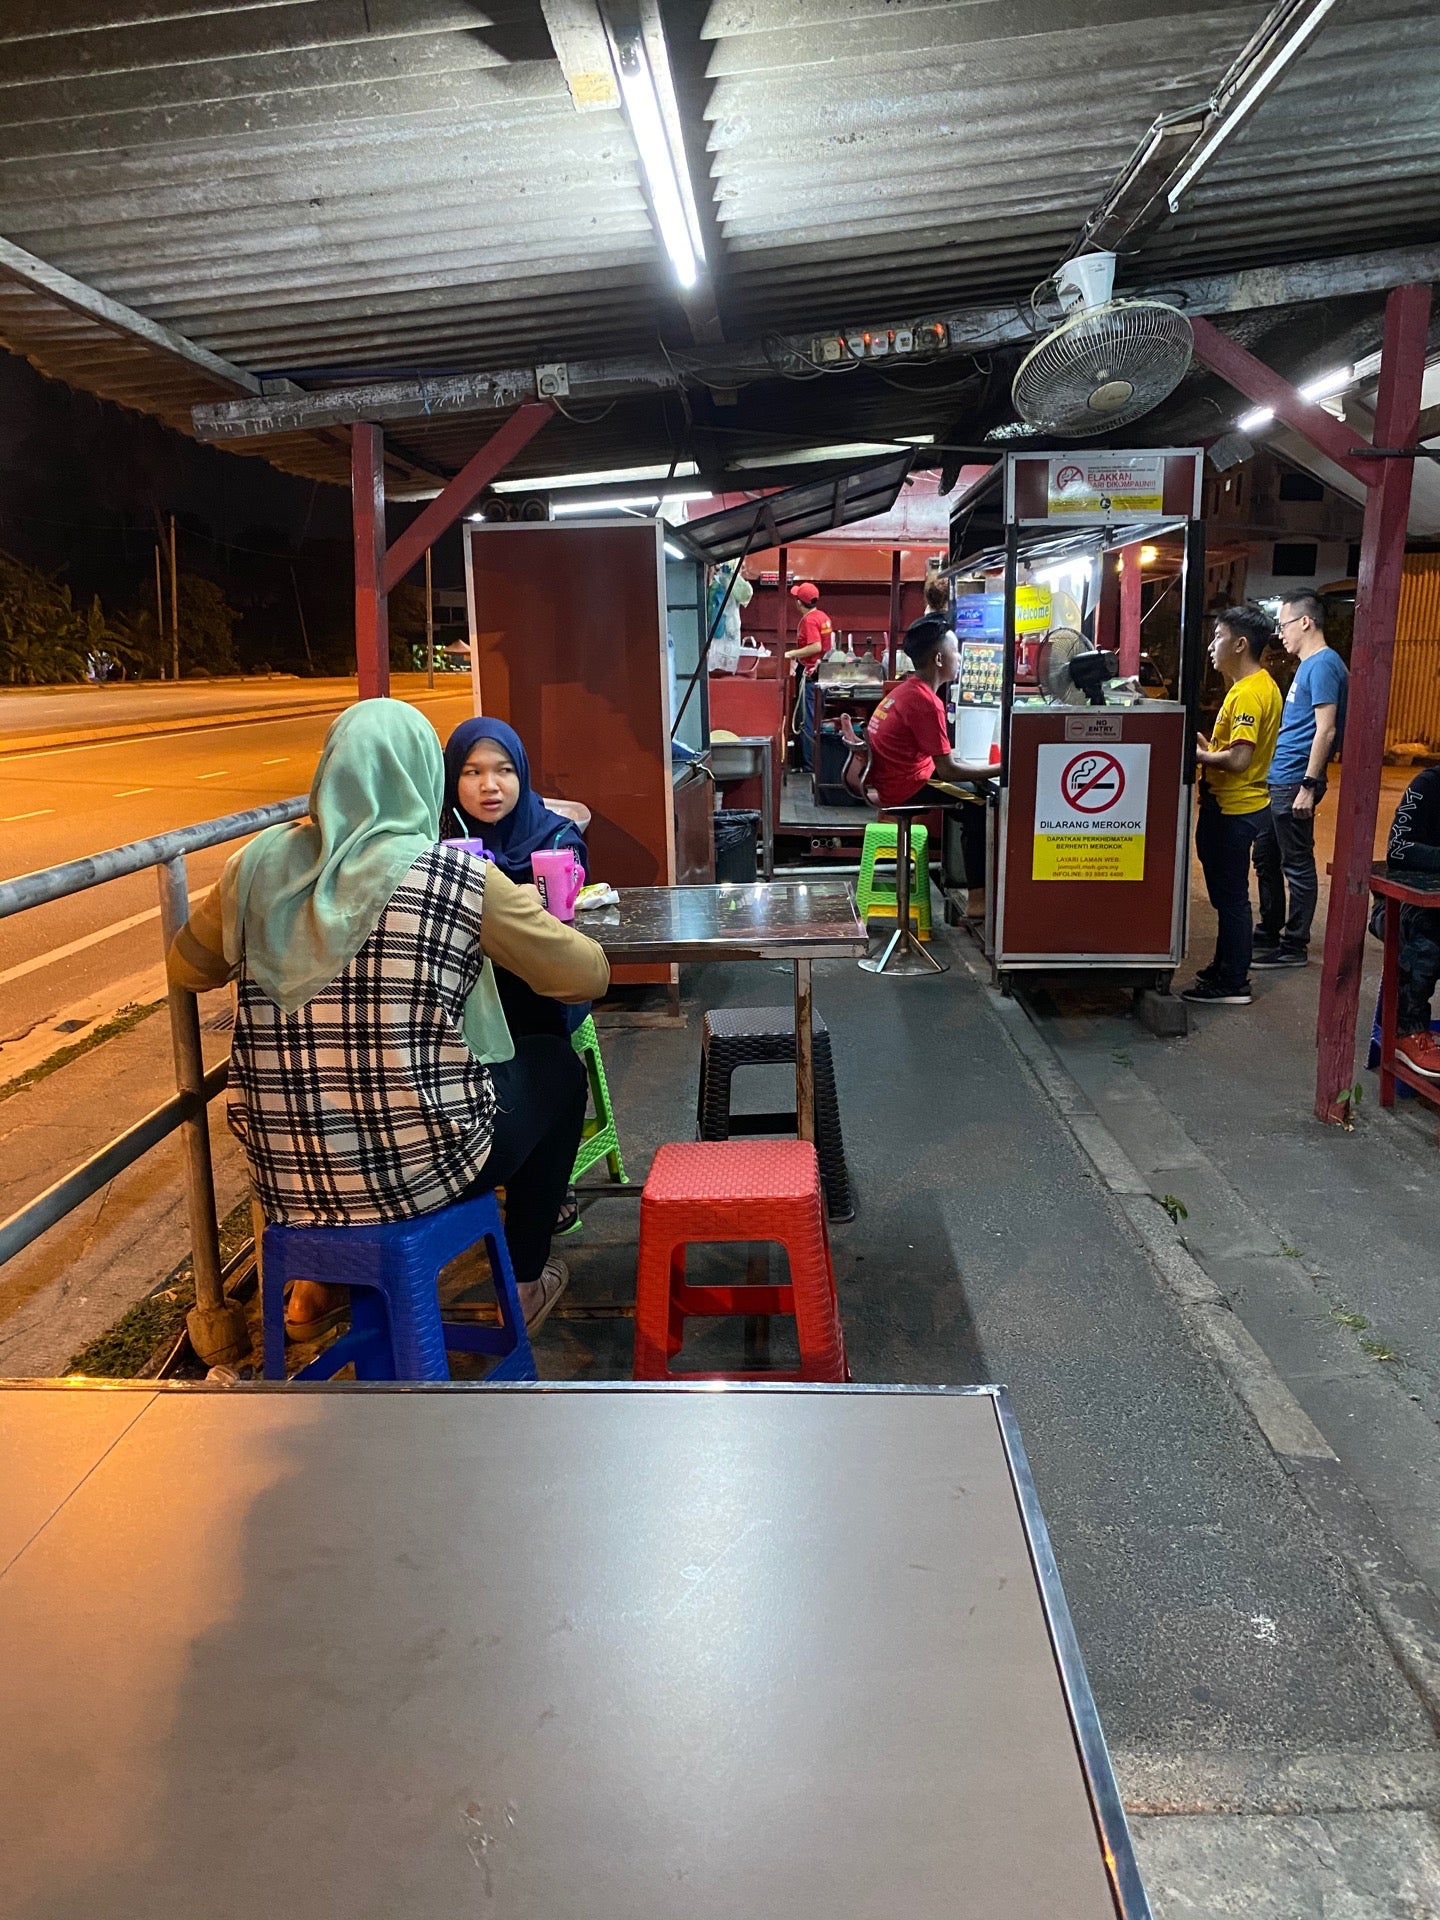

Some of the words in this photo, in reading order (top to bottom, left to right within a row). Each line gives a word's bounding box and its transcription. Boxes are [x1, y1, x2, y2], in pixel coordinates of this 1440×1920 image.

[1087, 472, 1132, 481] ELAKKAN
[1088, 481, 1105, 489] ARI
[1040, 821, 1089, 829] DILARANG
[1092, 821, 1141, 829] MEROKOK
